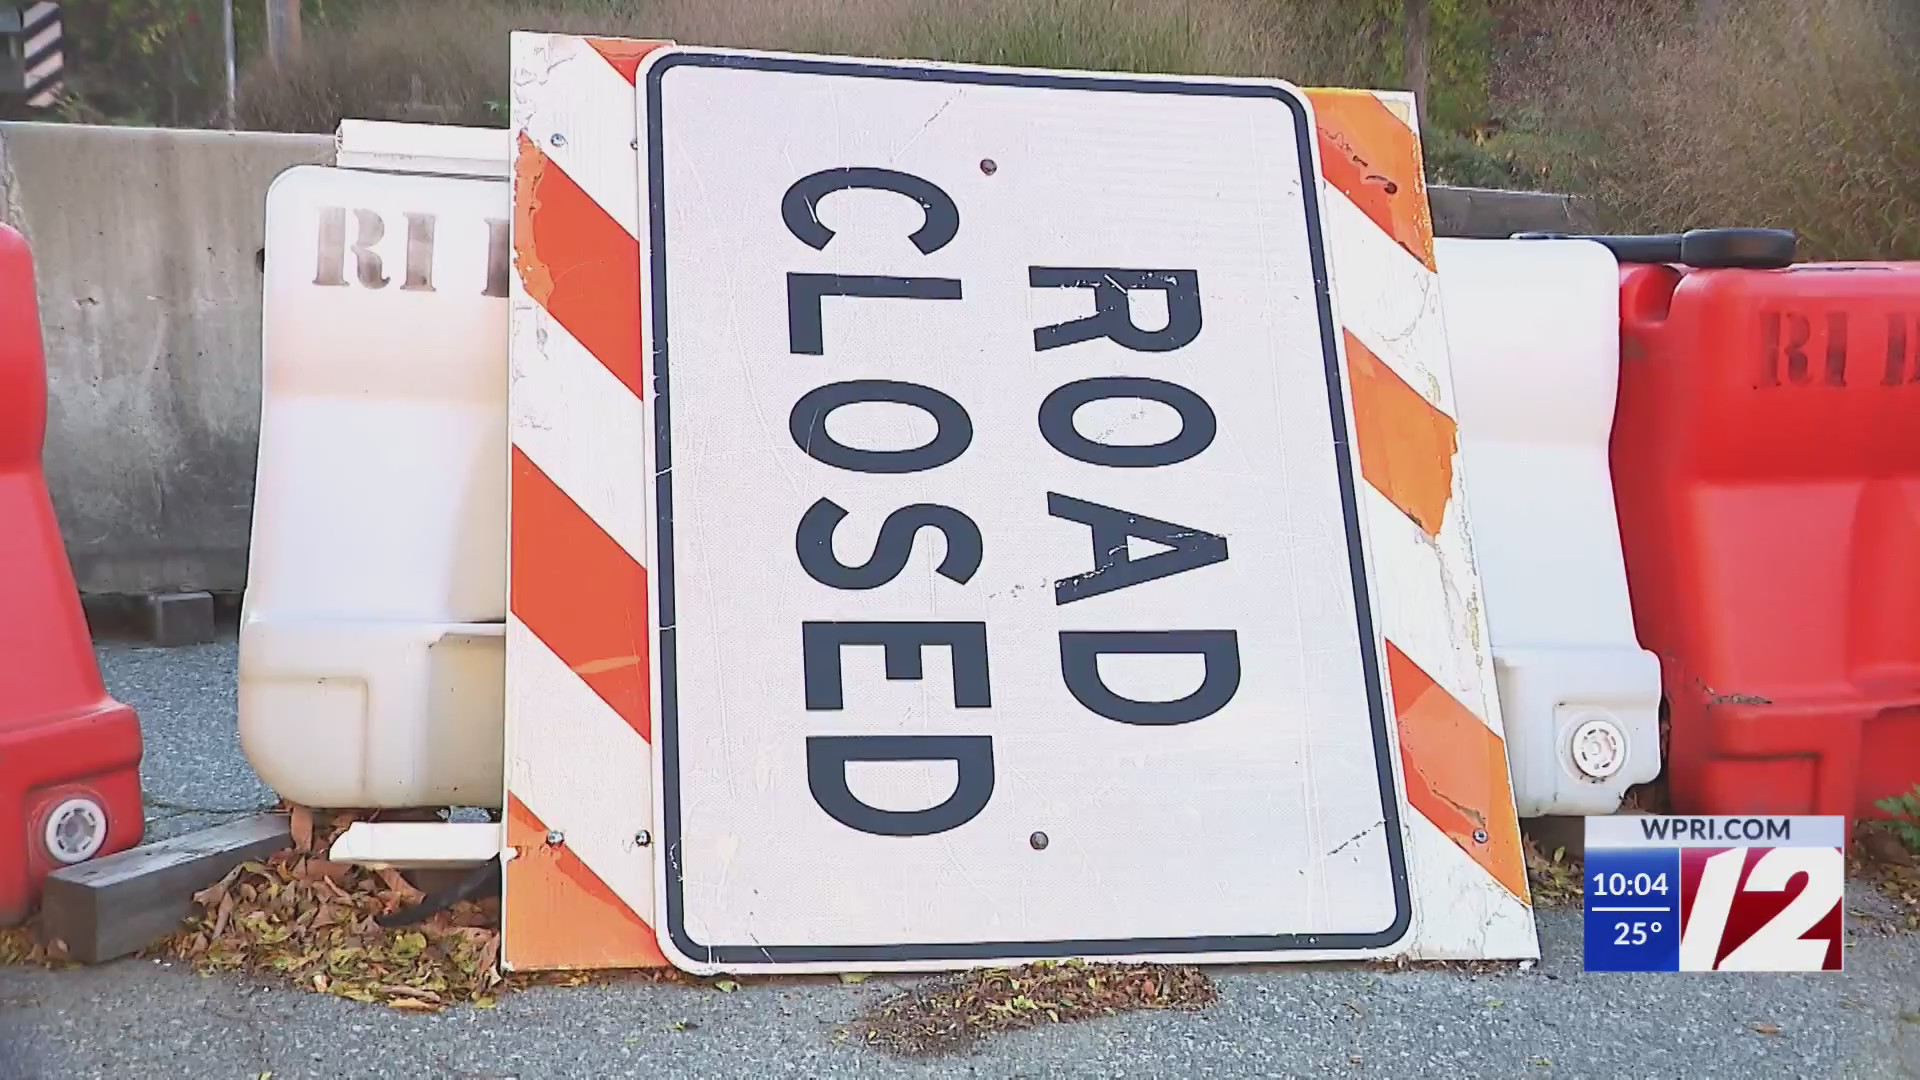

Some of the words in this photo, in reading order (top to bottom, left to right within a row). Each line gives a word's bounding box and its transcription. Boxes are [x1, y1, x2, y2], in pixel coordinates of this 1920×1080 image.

[312, 206, 437, 292] RI
[1754, 310, 1848, 389] RI
[781, 166, 996, 837] CLOSED
[1029, 265, 1242, 726] ROAD
